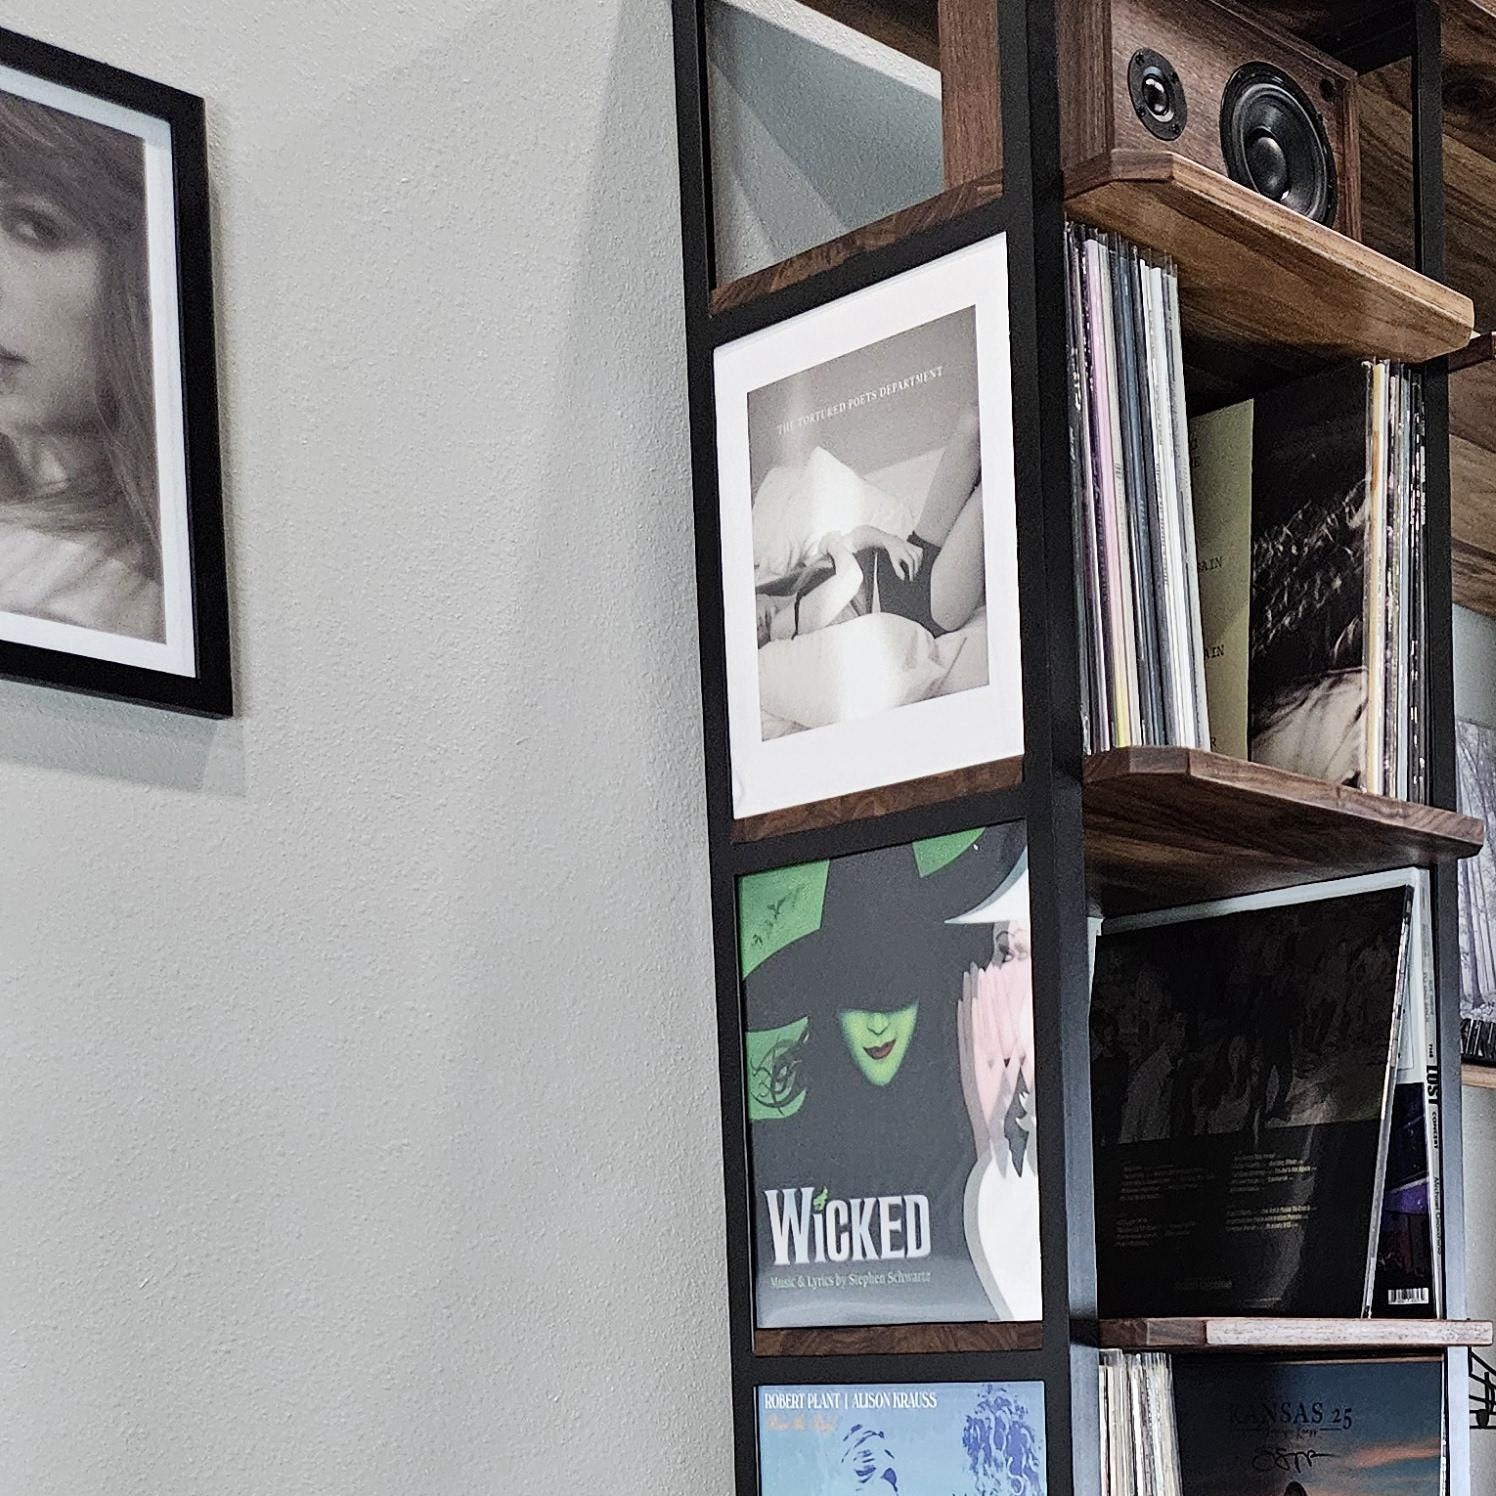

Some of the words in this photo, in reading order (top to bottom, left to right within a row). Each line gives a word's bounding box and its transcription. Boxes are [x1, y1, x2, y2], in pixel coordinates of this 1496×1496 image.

[798, 402, 846, 426] TORTURED
[848, 390, 877, 410] POETS
[879, 365, 944, 399] DEPARTMENT
[807, 1276, 834, 1290] Lyrics
[835, 1273, 846, 1289] by
[849, 1272, 886, 1288] Stephen
[887, 1270, 931, 1284] Schwartz
[765, 1392, 804, 1409] ROBERT
[807, 1392, 840, 1409] PLANT
[852, 1391, 890, 1409] ALISON
[893, 1391, 937, 1408] KRAUSS
[1332, 1408, 1352, 1430] 25
